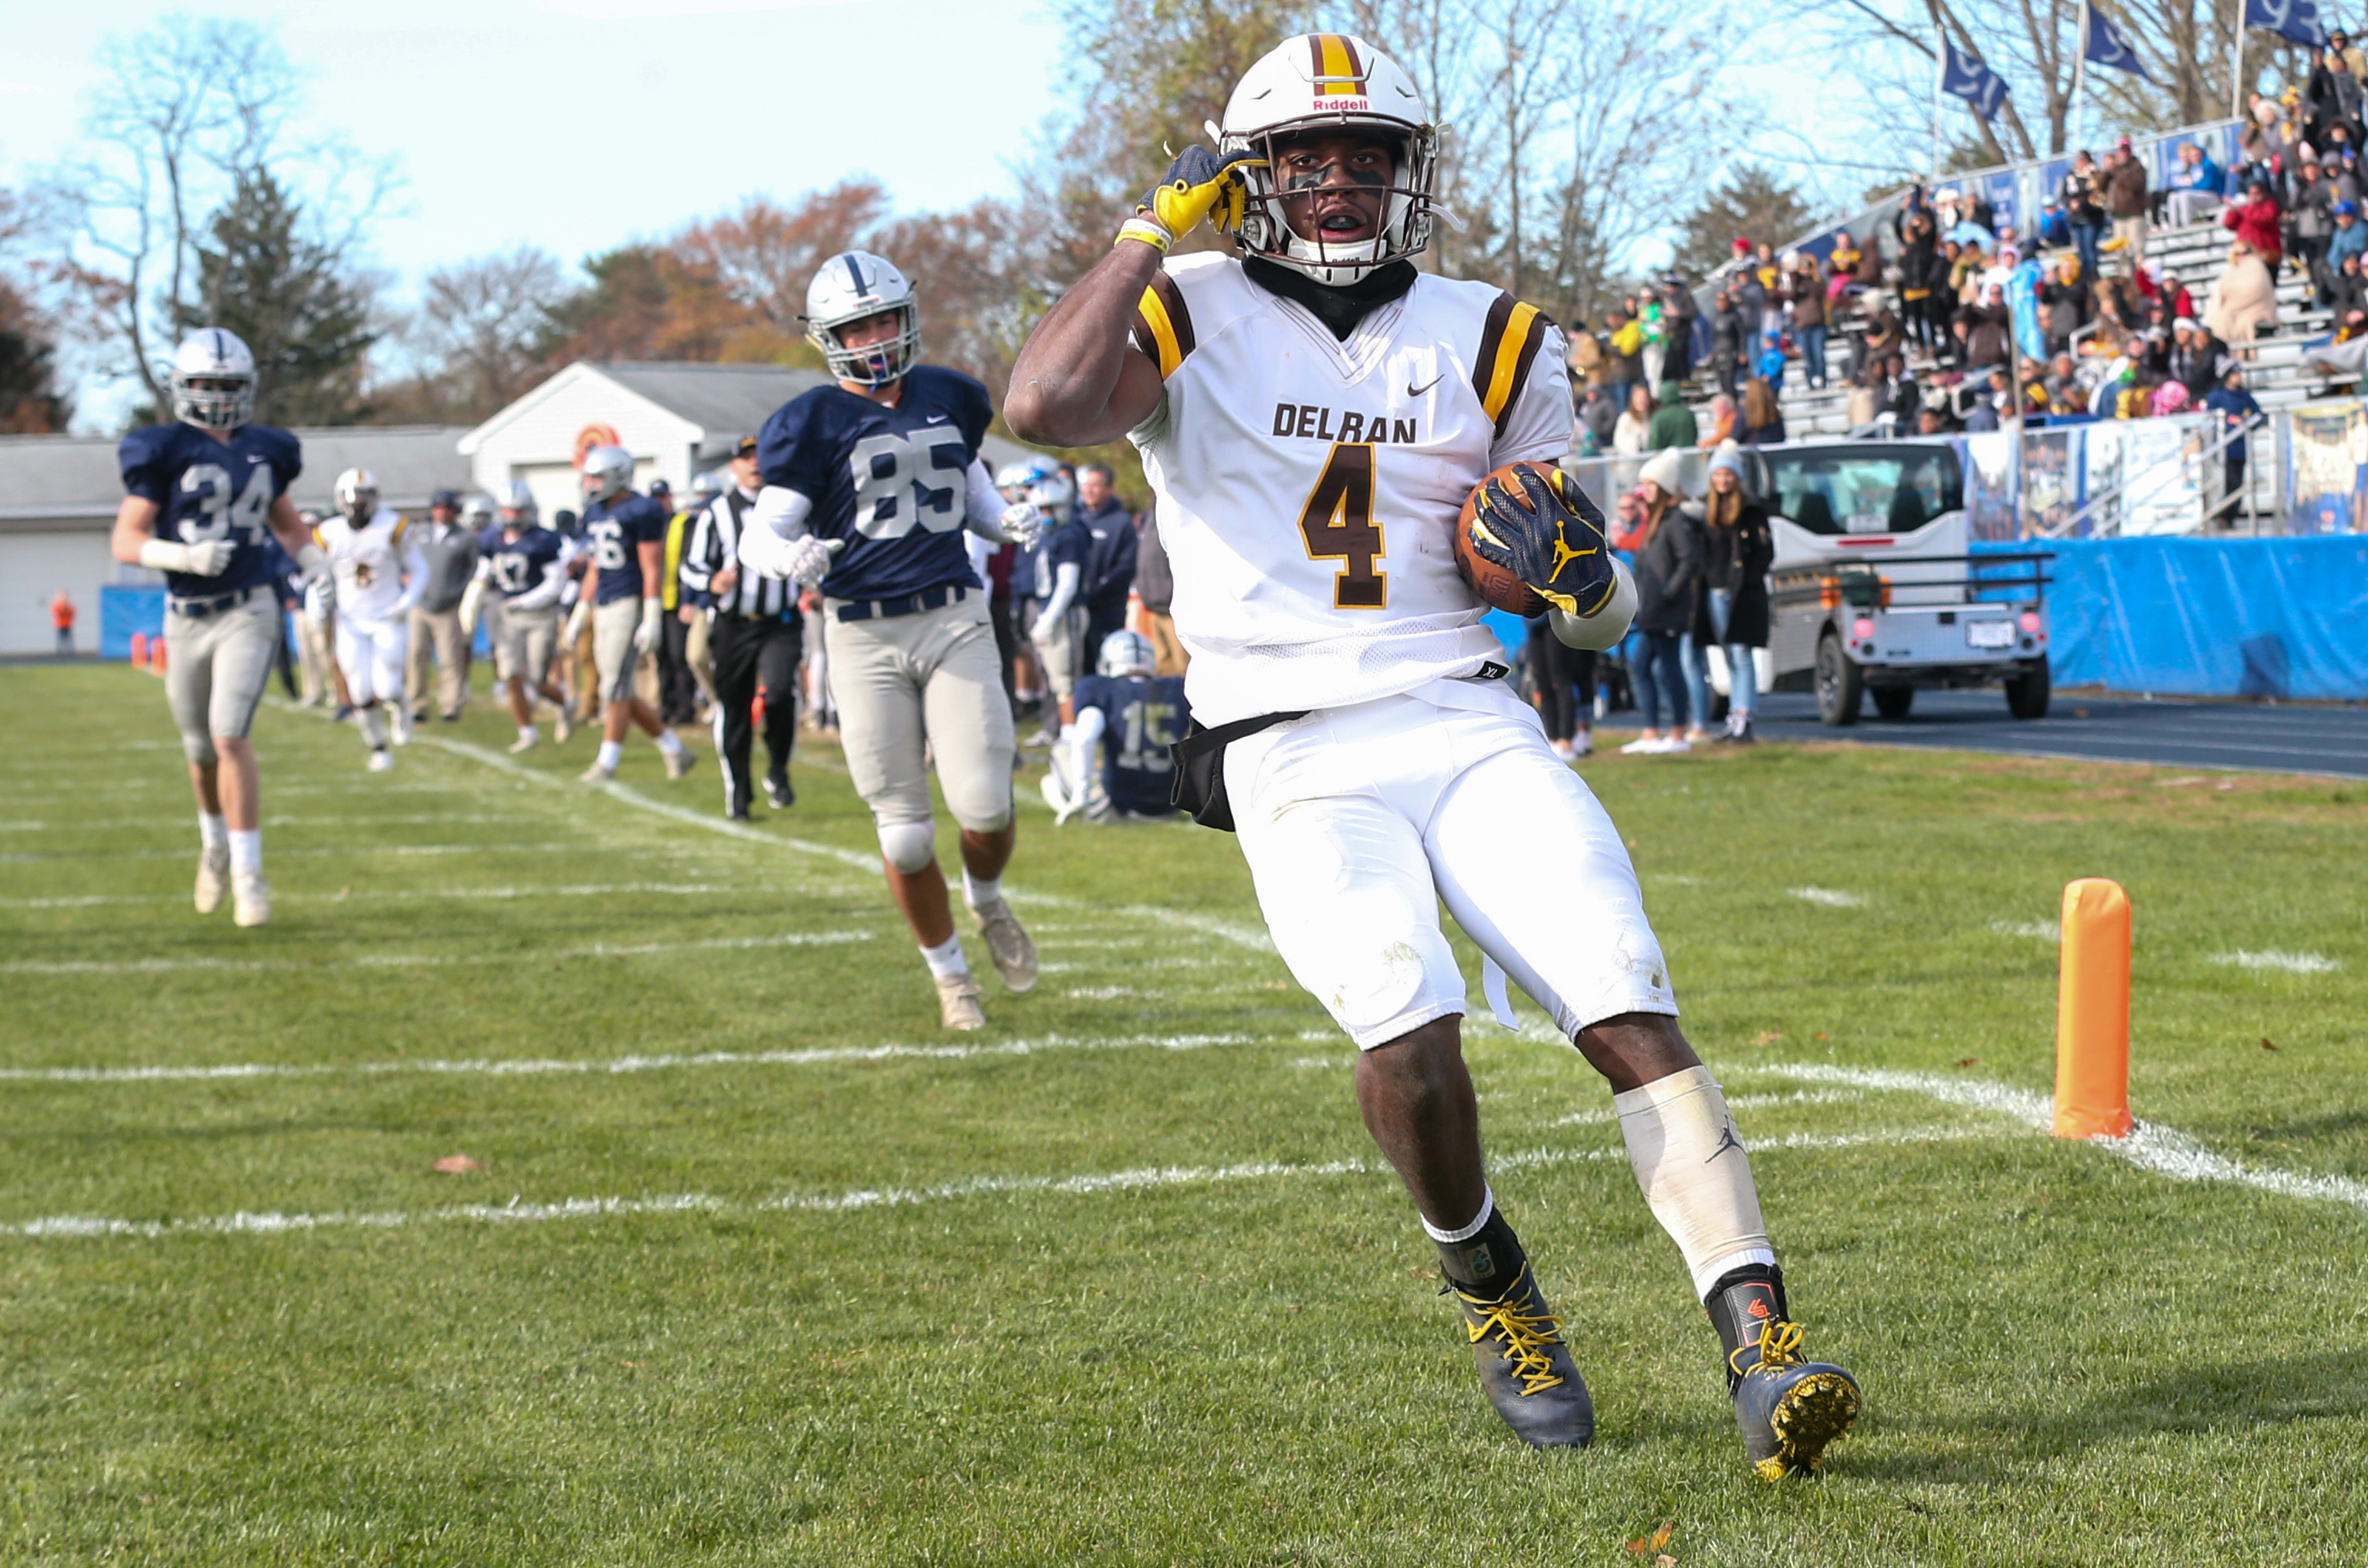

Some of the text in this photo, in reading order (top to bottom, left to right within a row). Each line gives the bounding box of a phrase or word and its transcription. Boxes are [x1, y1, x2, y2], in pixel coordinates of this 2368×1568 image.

[1313, 100, 1368, 110] Riddell
[1273, 403, 1417, 444] DELRAN
[178, 463, 274, 546] 34
[849, 425, 966, 539] 85
[1297, 441, 1387, 610] 4
[1483, 666, 1498, 678] XL
[1118, 701, 1178, 773] 15
